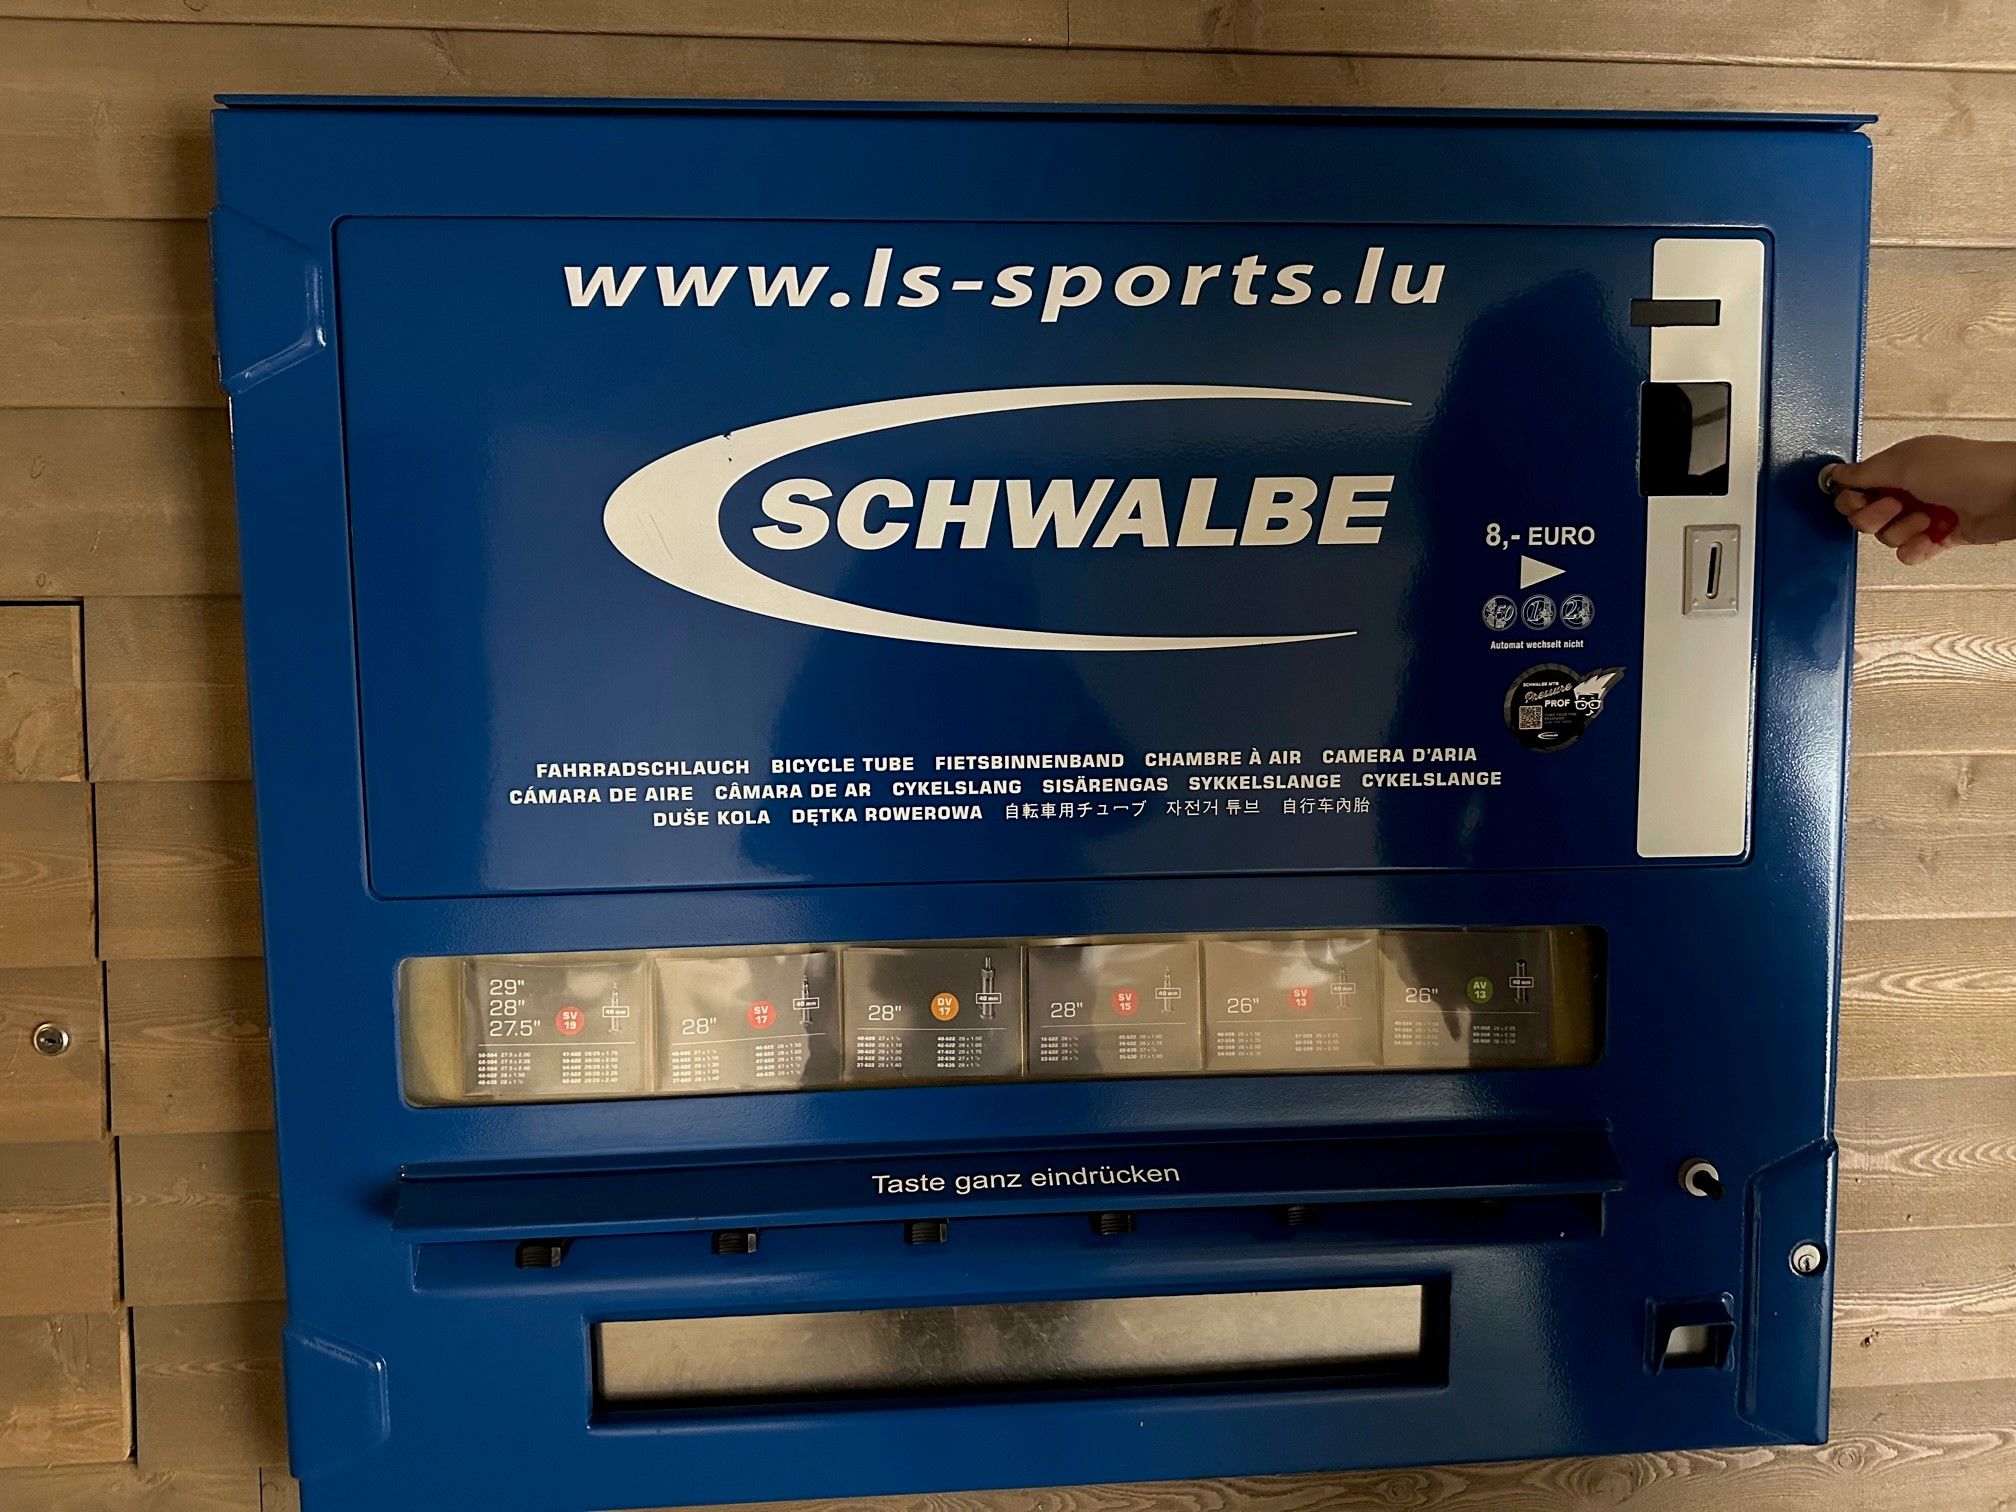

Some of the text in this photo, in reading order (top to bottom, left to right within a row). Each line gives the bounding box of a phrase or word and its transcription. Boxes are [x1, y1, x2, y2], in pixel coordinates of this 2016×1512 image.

[564, 248, 1445, 322] www.ls-sports.lu
[753, 476, 1394, 550] SCHWALBE
[1529, 526, 1594, 545] EURO
[1491, 640, 1583, 649] Automat wechselt nicht
[1524, 683, 1572, 703] Pressure
[1544, 699, 1570, 708] PROF
[537, 748, 1476, 778] FAHRRADSCHLAUCH BICYCLE TUBE FIETSBINNENBAND CHAMBRE À AIR CAMERA D'ARIA
[510, 772, 1501, 804] CÁMARA DE AIRE CÂMARA DE AR CYKELSLANG SISÄRENGAS SYKKELSLANGE CYKELSLANGE
[654, 808, 709, 826] DUŠE
[718, 810, 770, 825] KOLA
[793, 808, 857, 826] DĘTKA
[866, 806, 982, 821] ROWEROWA
[1006, 800, 1146, 819] 自転車用チューブ
[1167, 799, 1217, 816] 자전거
[1226, 800, 1259, 815] 튜브
[490, 979, 525, 996] 29"
[1294, 989, 1307, 997] SV
[1473, 981, 1487, 990] AV
[937, 997, 952, 1006] DV
[1118, 993, 1132, 1001] SV
[1296, 998, 1306, 1006] 13
[1406, 988, 1438, 1003] 26"
[1475, 991, 1486, 999] 13
[490, 999, 525, 1017] 28"
[753, 1005, 769, 1014] SV
[868, 1005, 902, 1021] 28"
[939, 1007, 950, 1016] 17
[1051, 1002, 1083, 1018] 28"
[1120, 1002, 1131, 1010] 15
[1227, 998, 1259, 1013] 26"
[562, 1011, 578, 1020] SV
[755, 1015, 767, 1024] 17
[490, 1020, 541, 1037] 27.5"
[564, 1021, 576, 1030] 19
[682, 1018, 717, 1035] 28"
